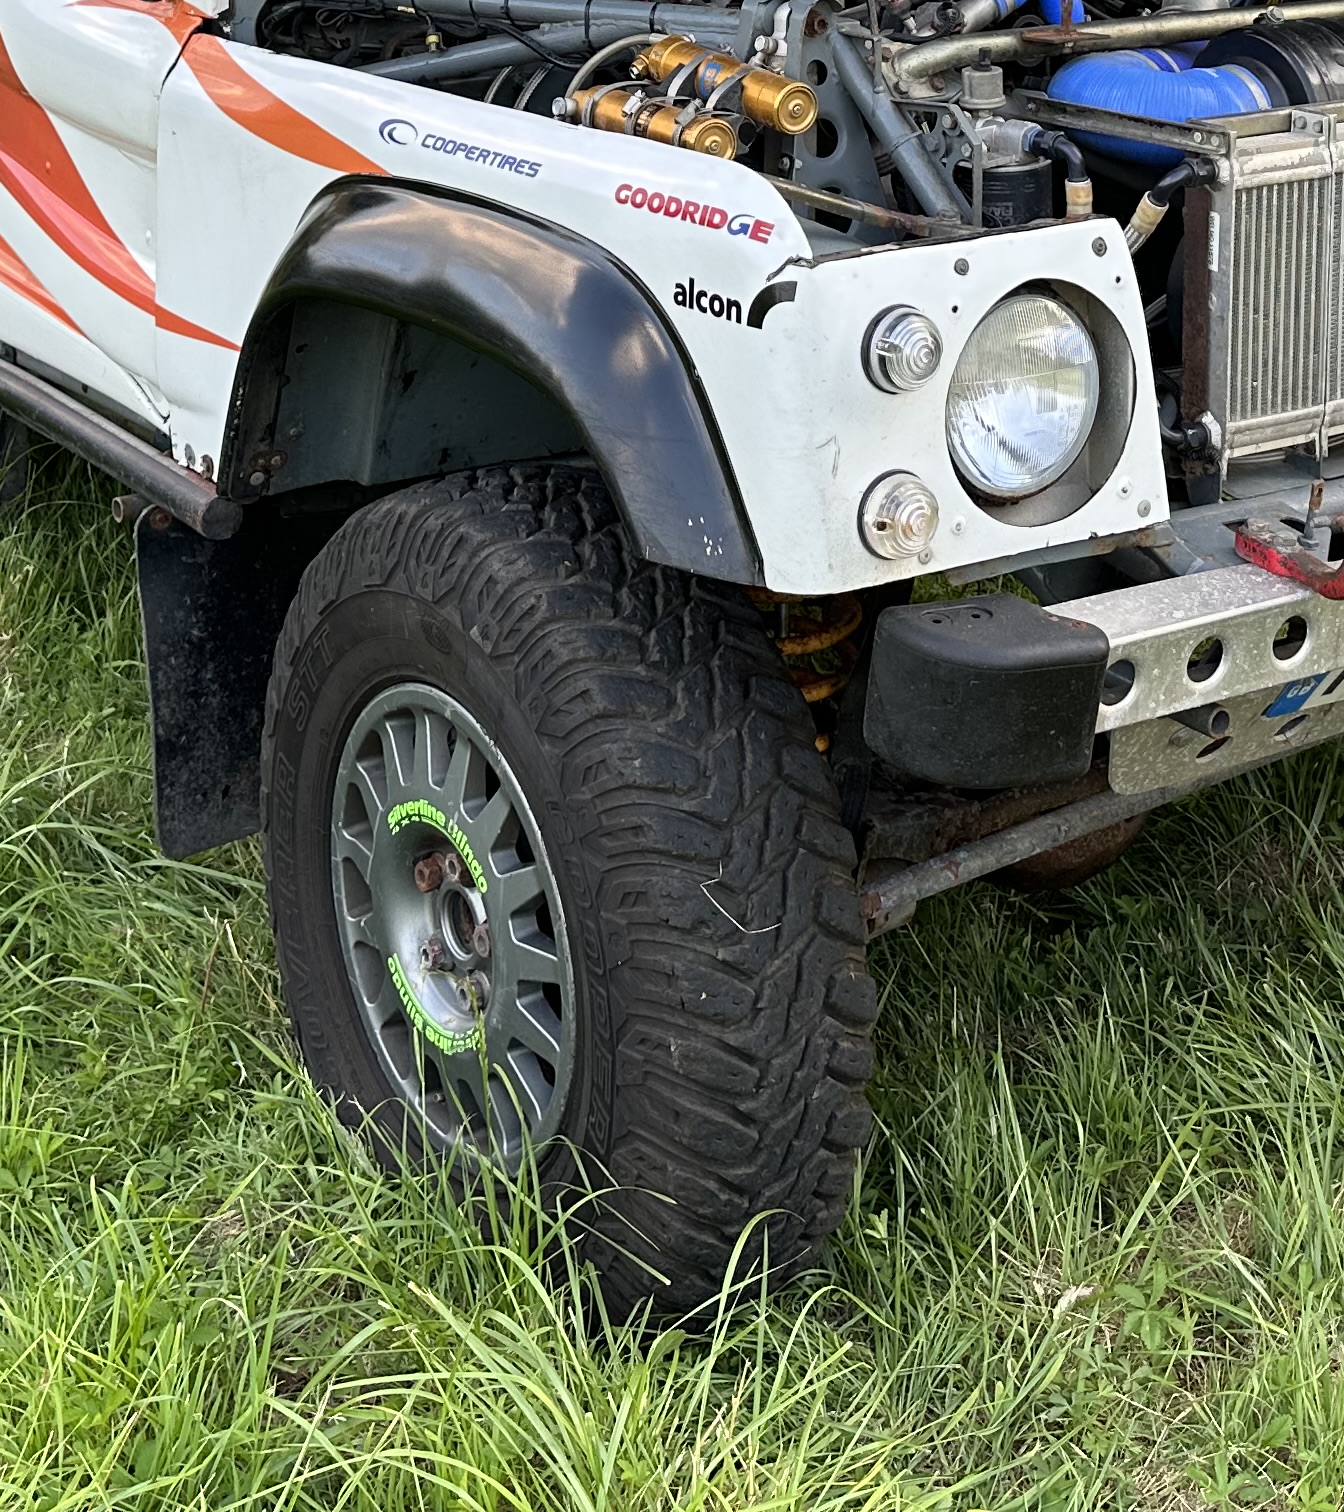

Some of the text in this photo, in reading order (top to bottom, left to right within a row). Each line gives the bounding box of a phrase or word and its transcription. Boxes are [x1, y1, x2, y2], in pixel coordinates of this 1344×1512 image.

[421, 133, 542, 179] COOPERTIRES
[614, 183, 776, 245] GOODRIDGE
[672, 277, 743, 325] alcon
